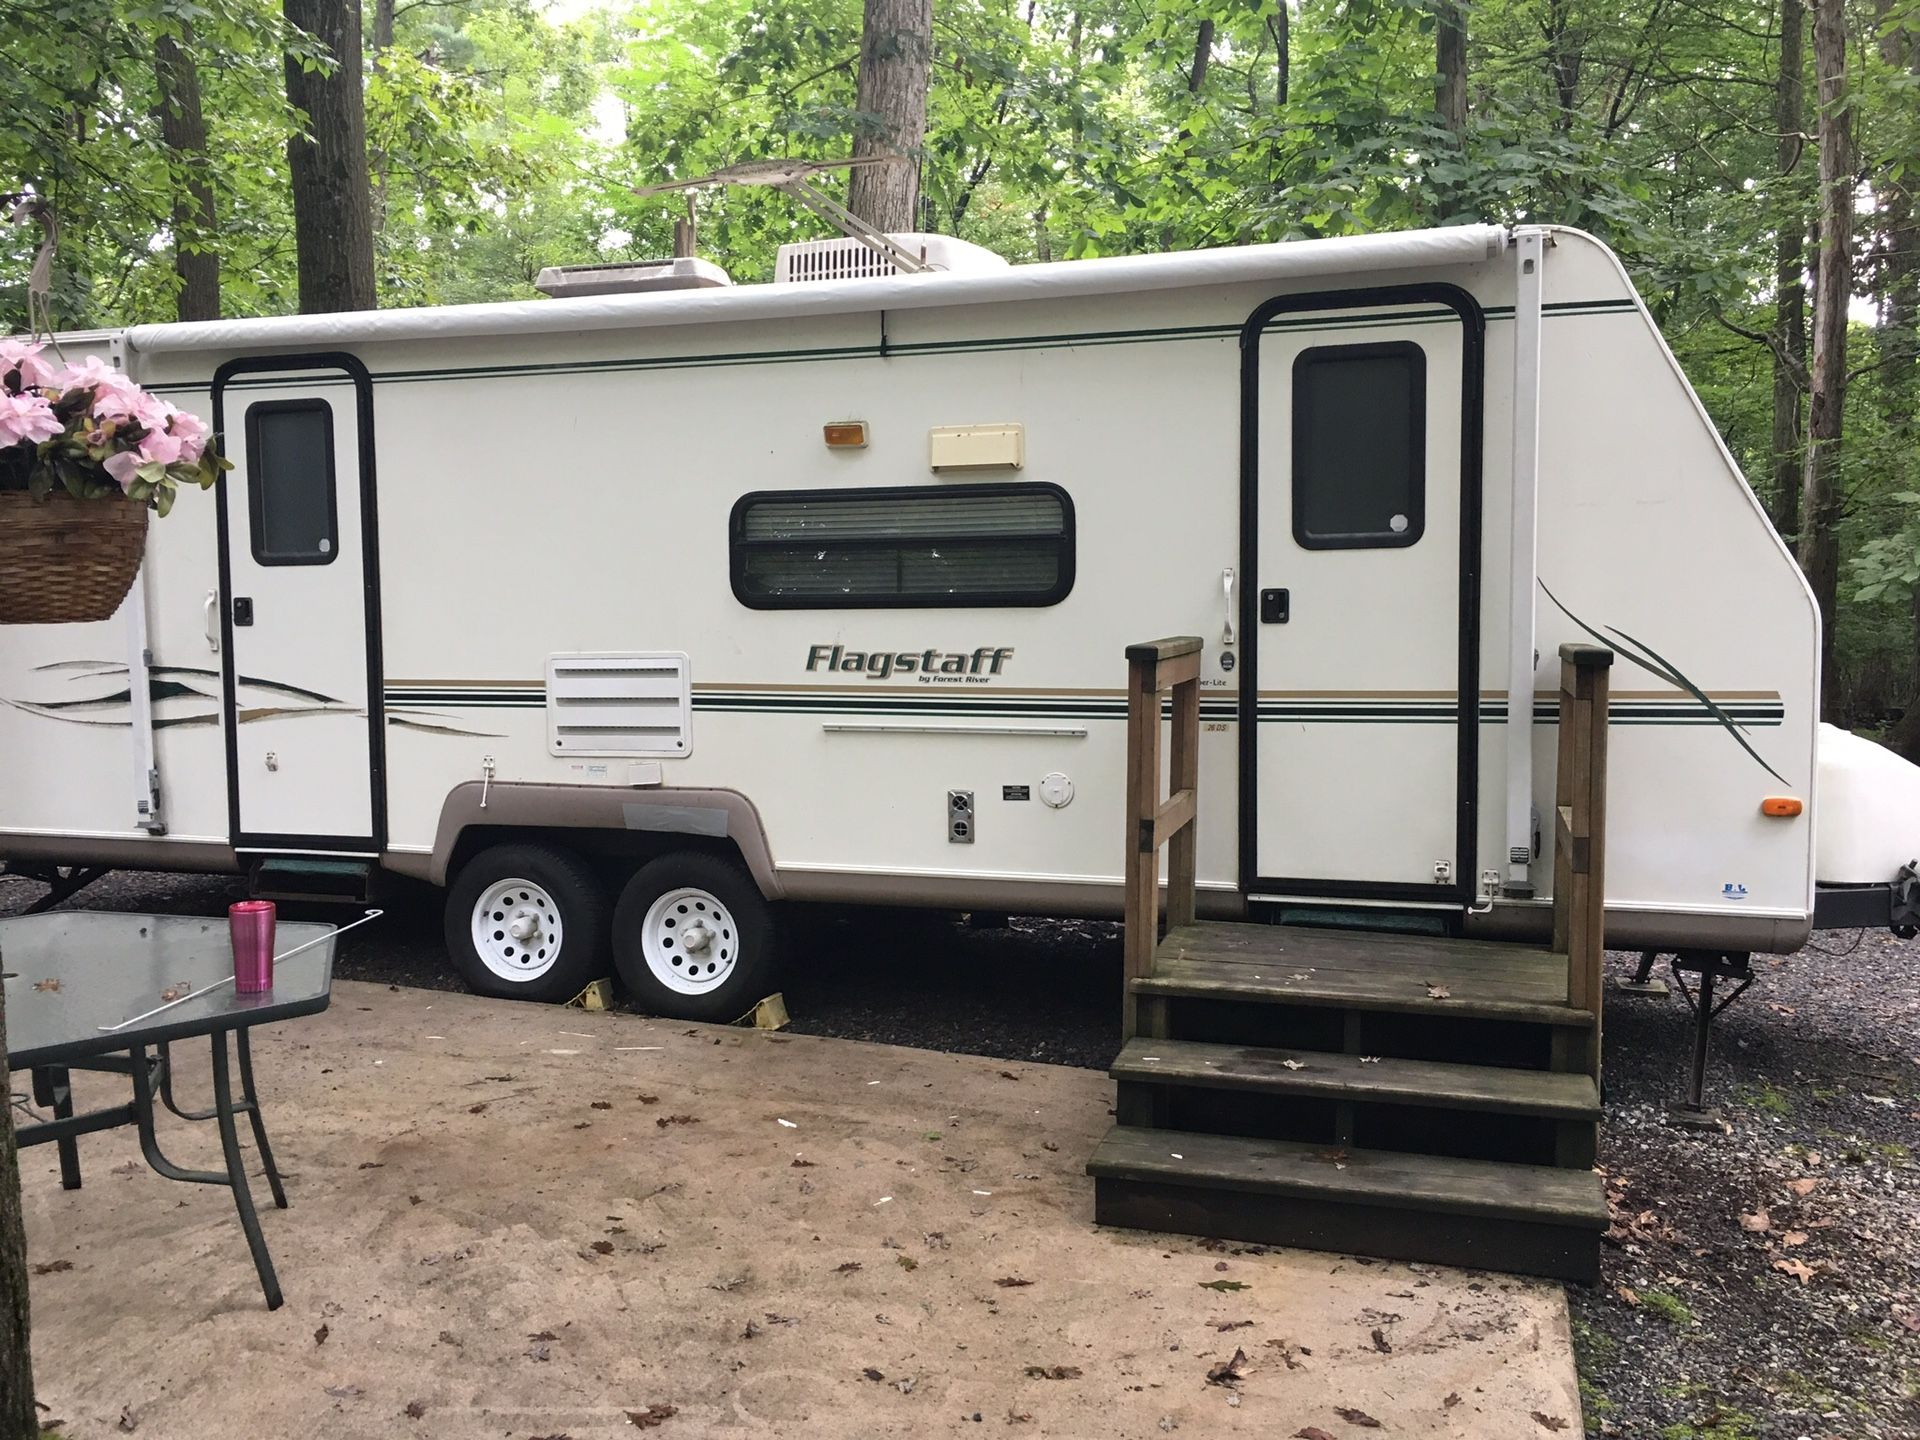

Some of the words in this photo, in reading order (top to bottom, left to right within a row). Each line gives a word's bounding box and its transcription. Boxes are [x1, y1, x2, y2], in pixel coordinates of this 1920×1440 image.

[805, 644, 1015, 680] Flagstaff
[918, 675, 931, 684] by
[933, 675, 963, 684] Forest
[965, 675, 991, 684] River
